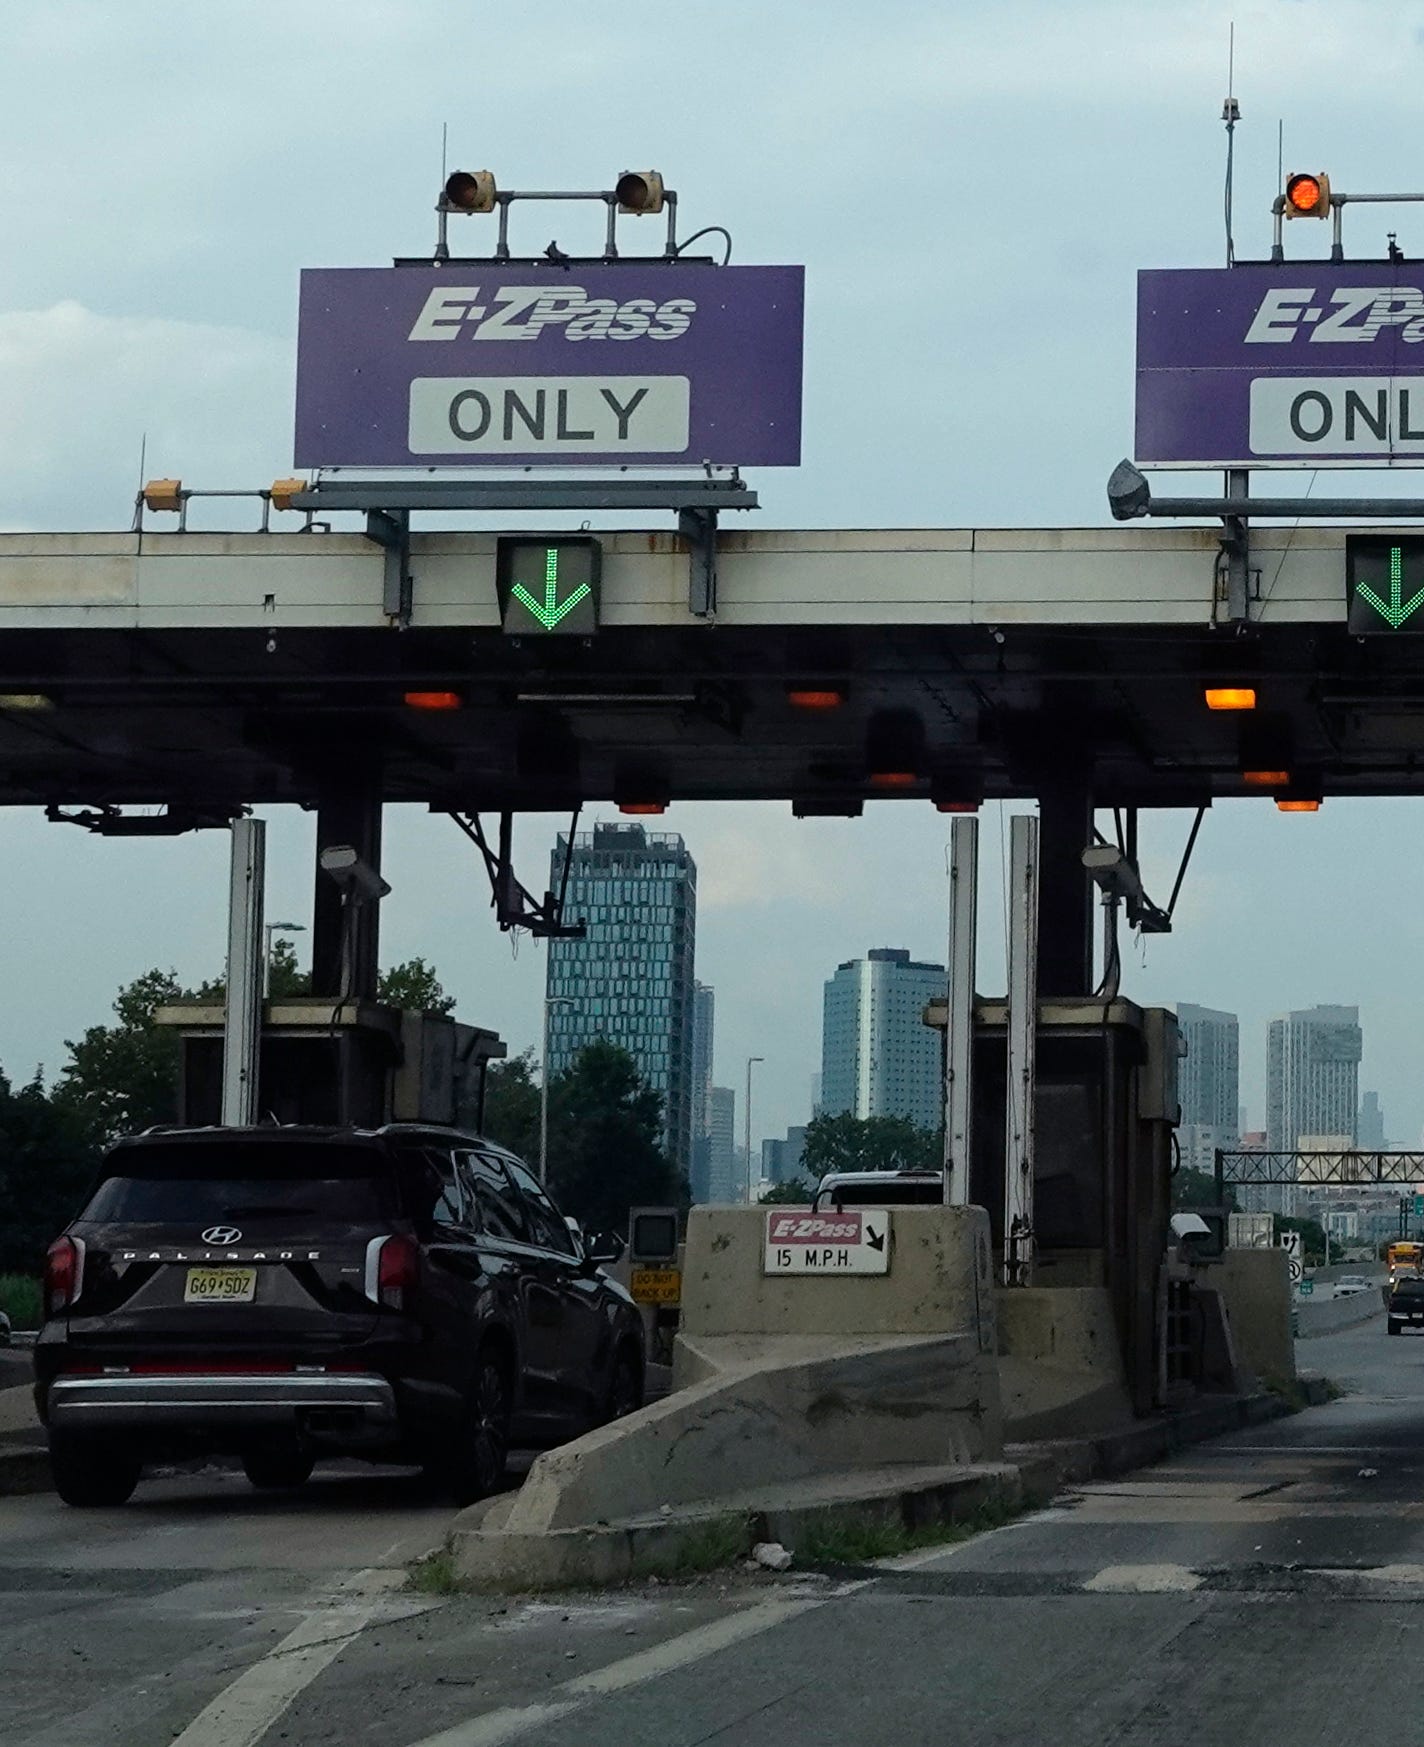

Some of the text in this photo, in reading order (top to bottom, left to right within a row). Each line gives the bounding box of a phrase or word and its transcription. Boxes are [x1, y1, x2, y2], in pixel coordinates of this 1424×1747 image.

[408, 286, 696, 341] E-ZPass
[448, 388, 649, 441] ONLY
[123, 1251, 320, 1260] PALISADE
[777, 1250, 852, 1267] 15 M.P.H.
[636, 1274, 672, 1284] DO NOT
